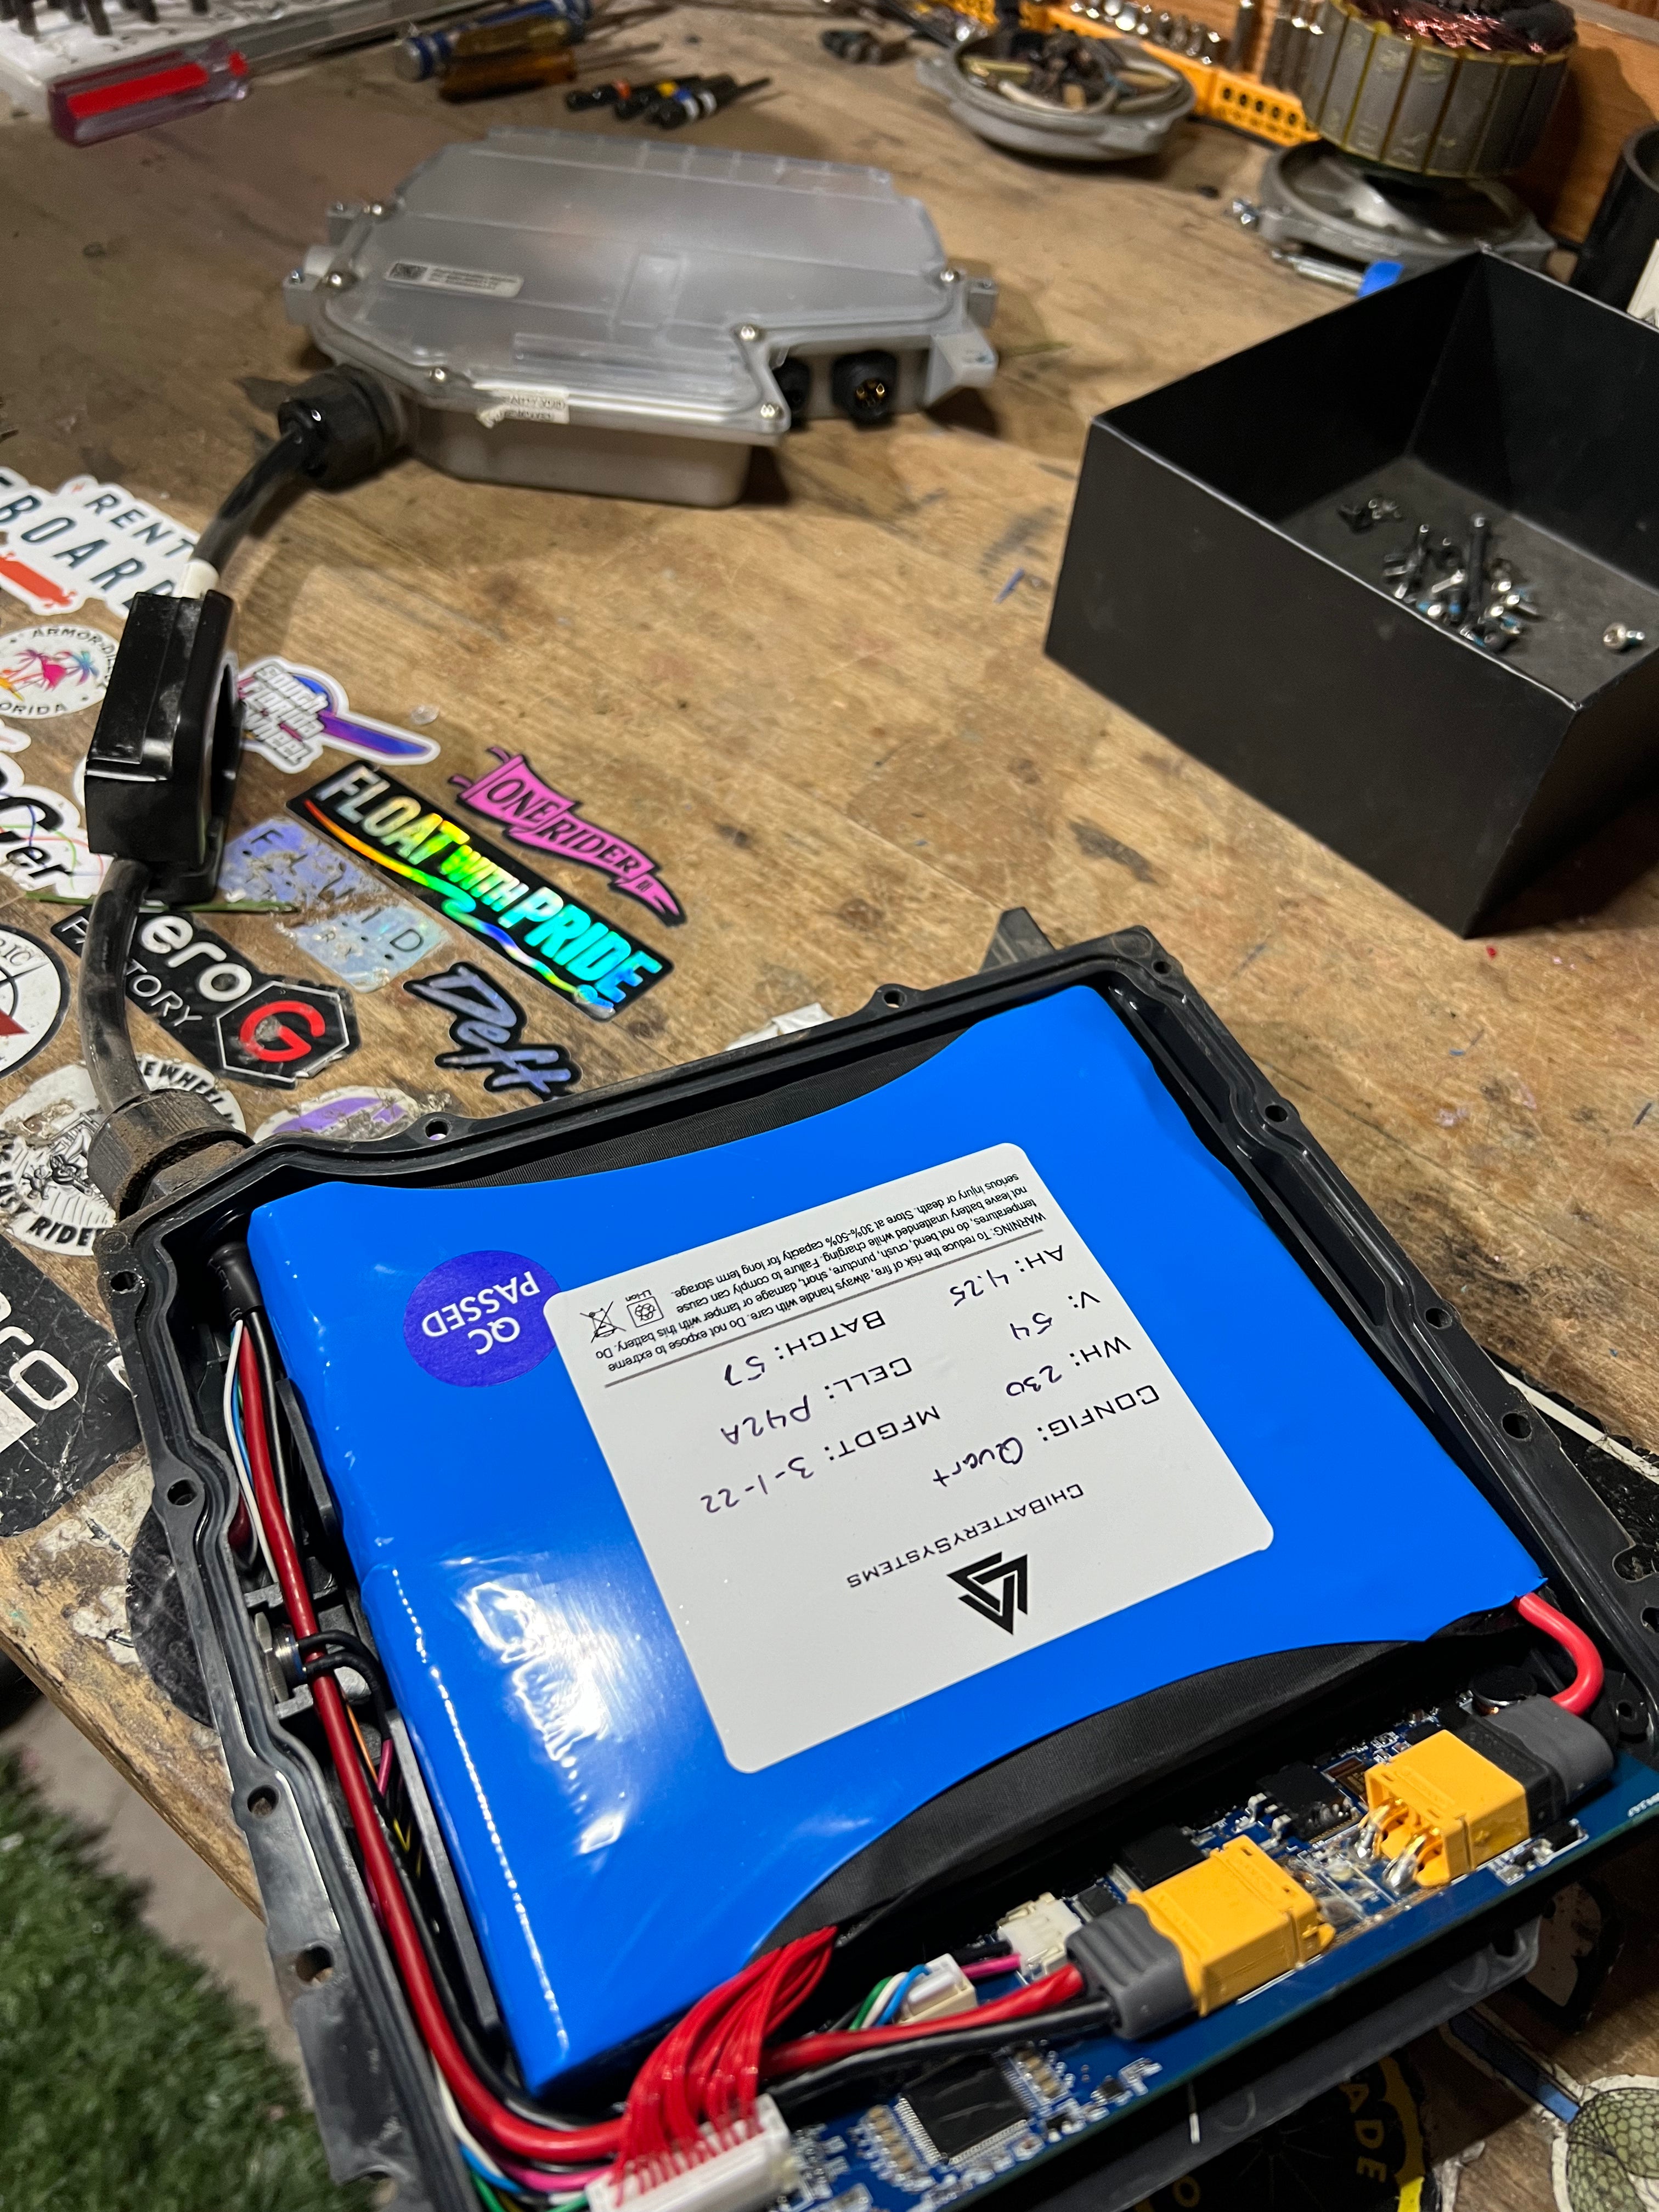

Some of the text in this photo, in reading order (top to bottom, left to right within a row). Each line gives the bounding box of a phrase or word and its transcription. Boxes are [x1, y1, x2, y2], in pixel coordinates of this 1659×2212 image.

[0, 701, 67, 714] ORIDA
[315, 766, 662, 1003] FLOAT WITH PRIDE
[29, 1216, 105, 1246] RIDE
[670, 1173, 1019, 1297] serious injury or death. Store at 30%-50% capacity for long term storage.
[675, 1185, 1028, 1313] not leave battery unattended while charging. Failure to comply can cause
[422, 1271, 541, 1338] PASSED
[595, 1198, 1037, 1359] temperatures, do not bend, crush, puncture, short, damage or tamper with this battery. Do
[607, 1211, 1047, 1372] WARNING: To reduce the risk of fire, always handle with care. Do not expose to extreme
[949, 1268, 1009, 1307] 4.25
[467, 1317, 520, 1355] QC
[1009, 1312, 1053, 1340] 54
[1005, 1364, 1063, 1397] 230
[699, 1455, 815, 1514] 3-1-22
